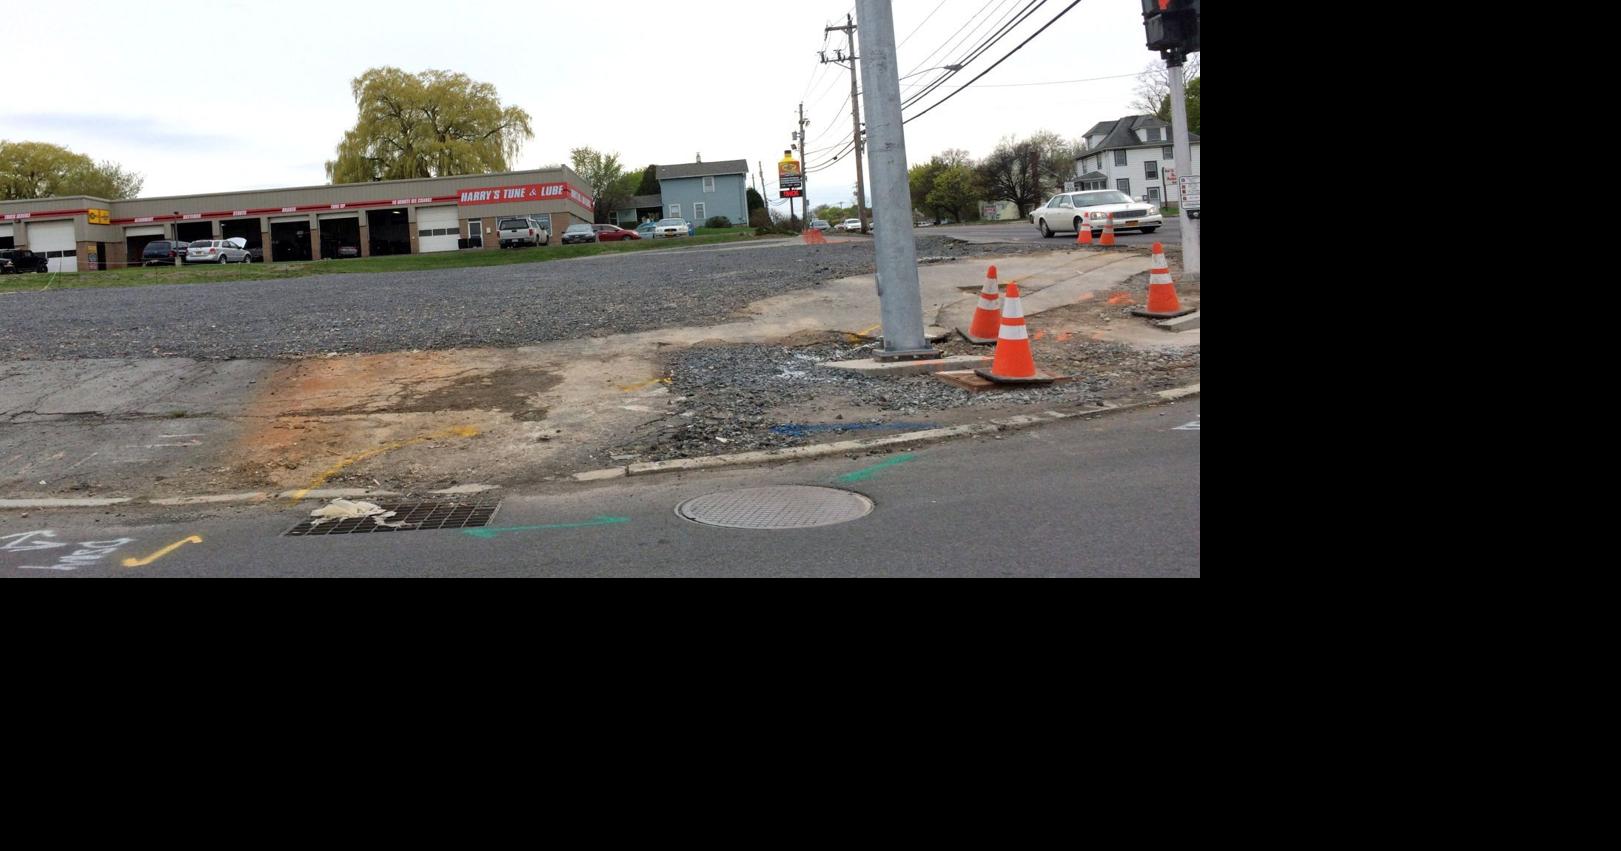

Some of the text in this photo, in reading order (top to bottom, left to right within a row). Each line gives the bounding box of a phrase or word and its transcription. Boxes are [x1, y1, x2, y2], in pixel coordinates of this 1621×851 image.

[460, 185, 564, 203] HARRY'S TUNE & LUBE
